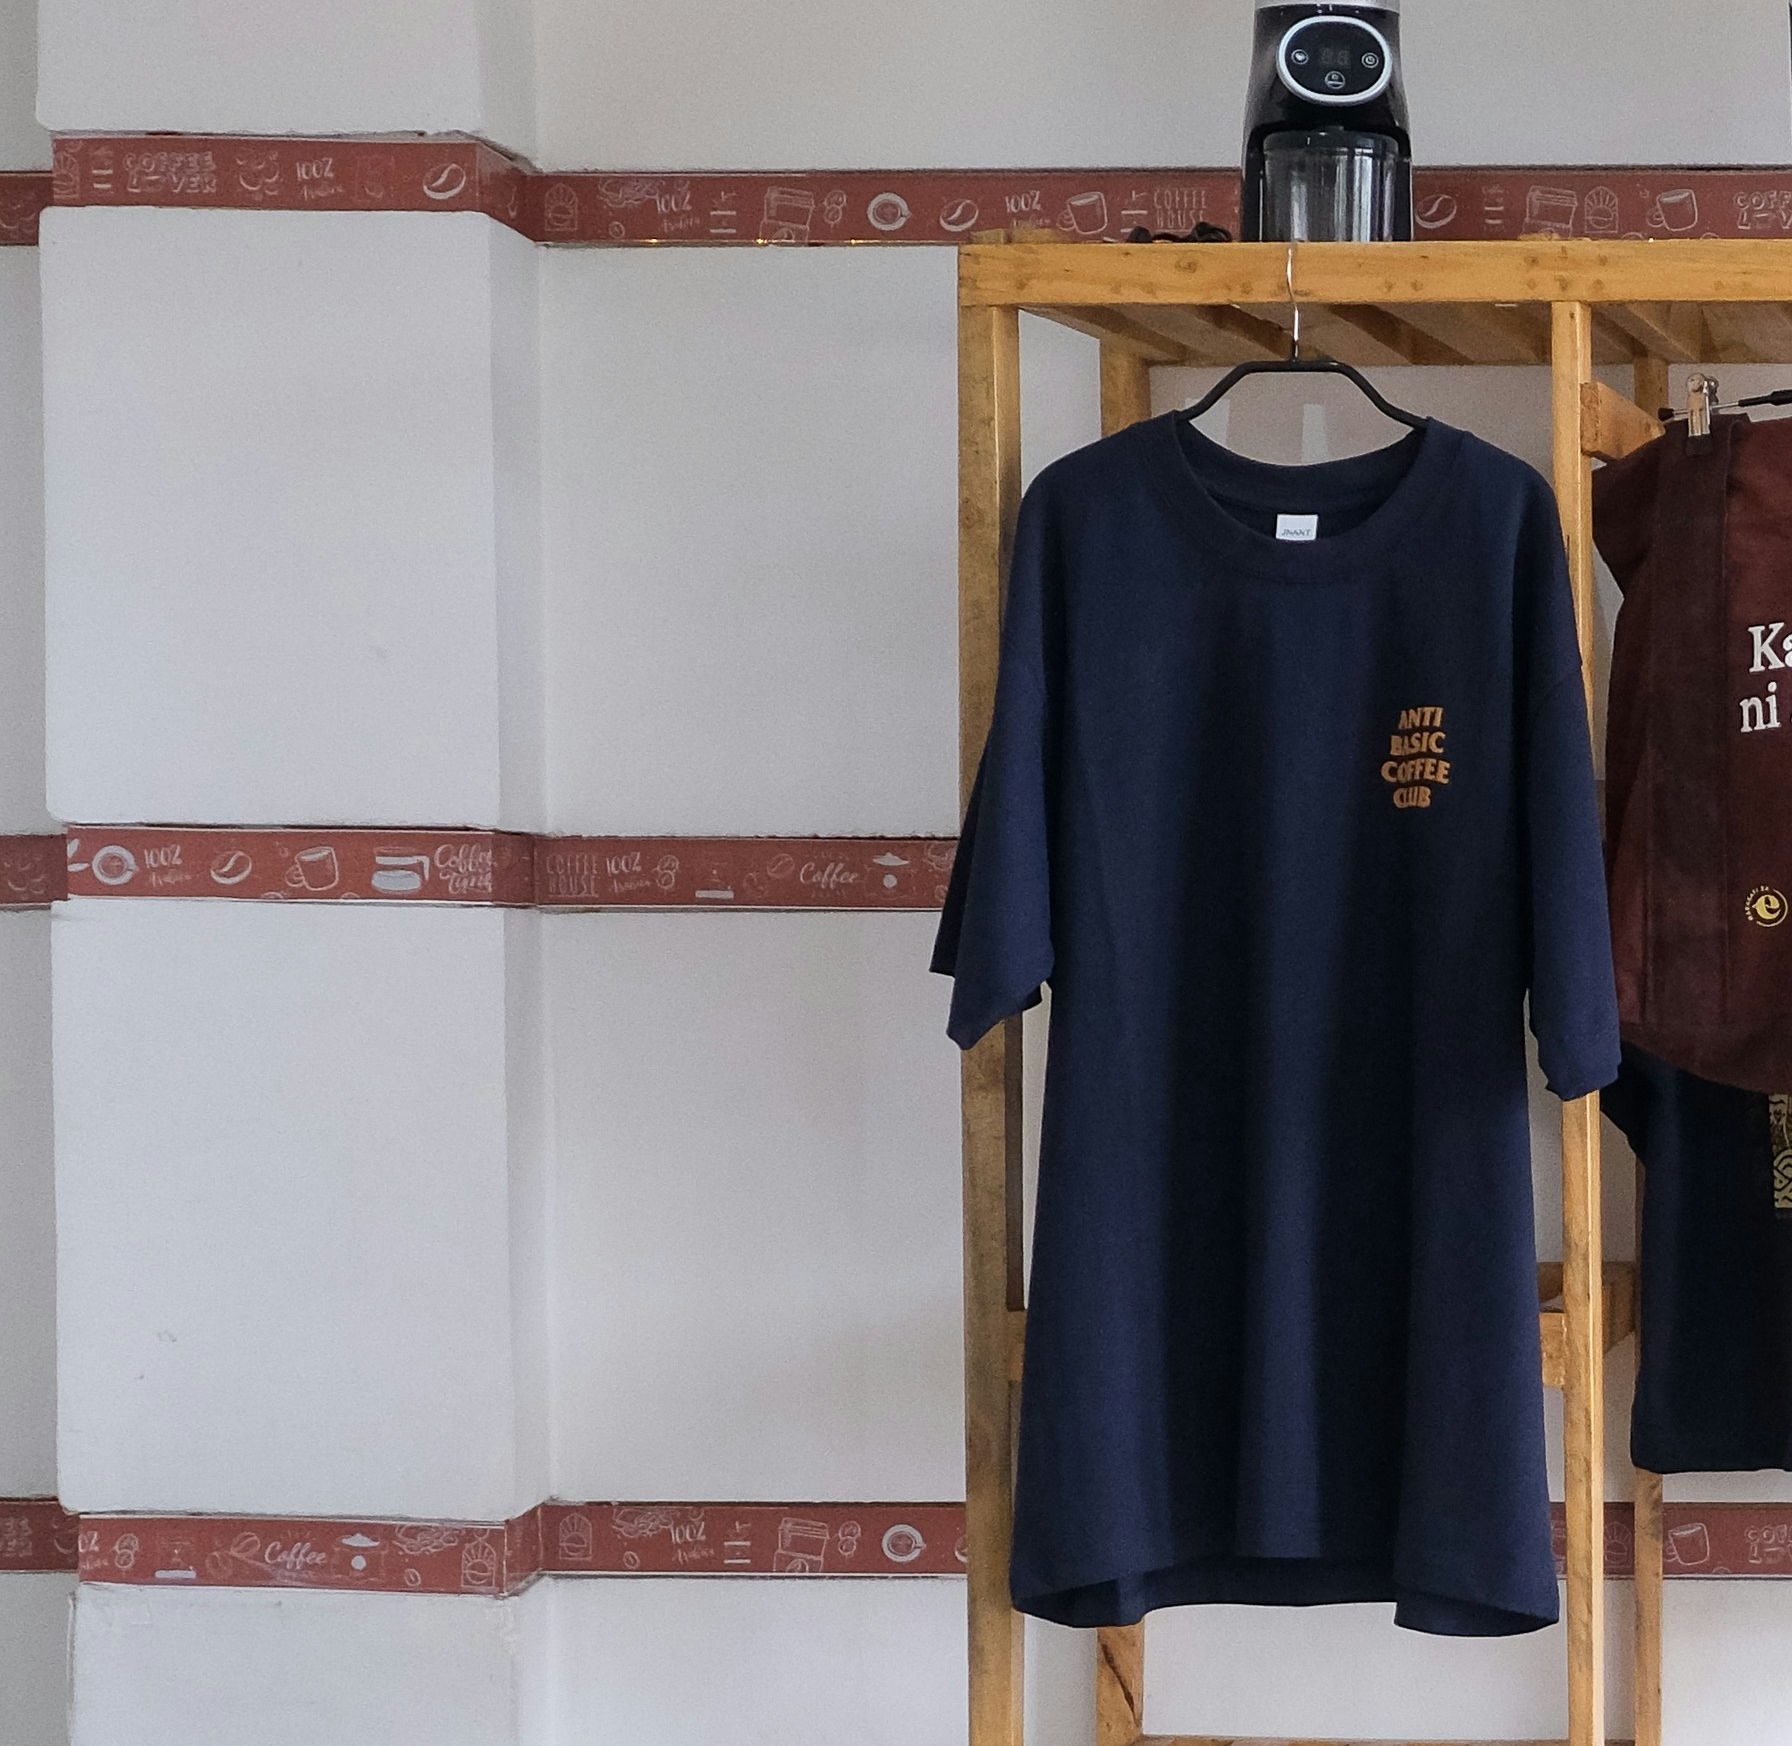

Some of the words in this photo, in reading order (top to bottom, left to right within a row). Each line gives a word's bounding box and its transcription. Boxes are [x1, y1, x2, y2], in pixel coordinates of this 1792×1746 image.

[122, 151, 217, 172] COFFEE
[295, 157, 334, 180] 100%
[1004, 191, 1041, 213] 100%
[1398, 706, 1444, 730] ANTI
[1739, 681, 1781, 733] ni
[1389, 731, 1446, 756] BASIC
[1381, 757, 1451, 784] COFFEE
[1392, 786, 1431, 809] CLUB
[143, 844, 182, 869] 100%
[605, 852, 641, 876] 100%
[799, 862, 858, 889] Coffee
[264, 1541, 328, 1569] Coffee
